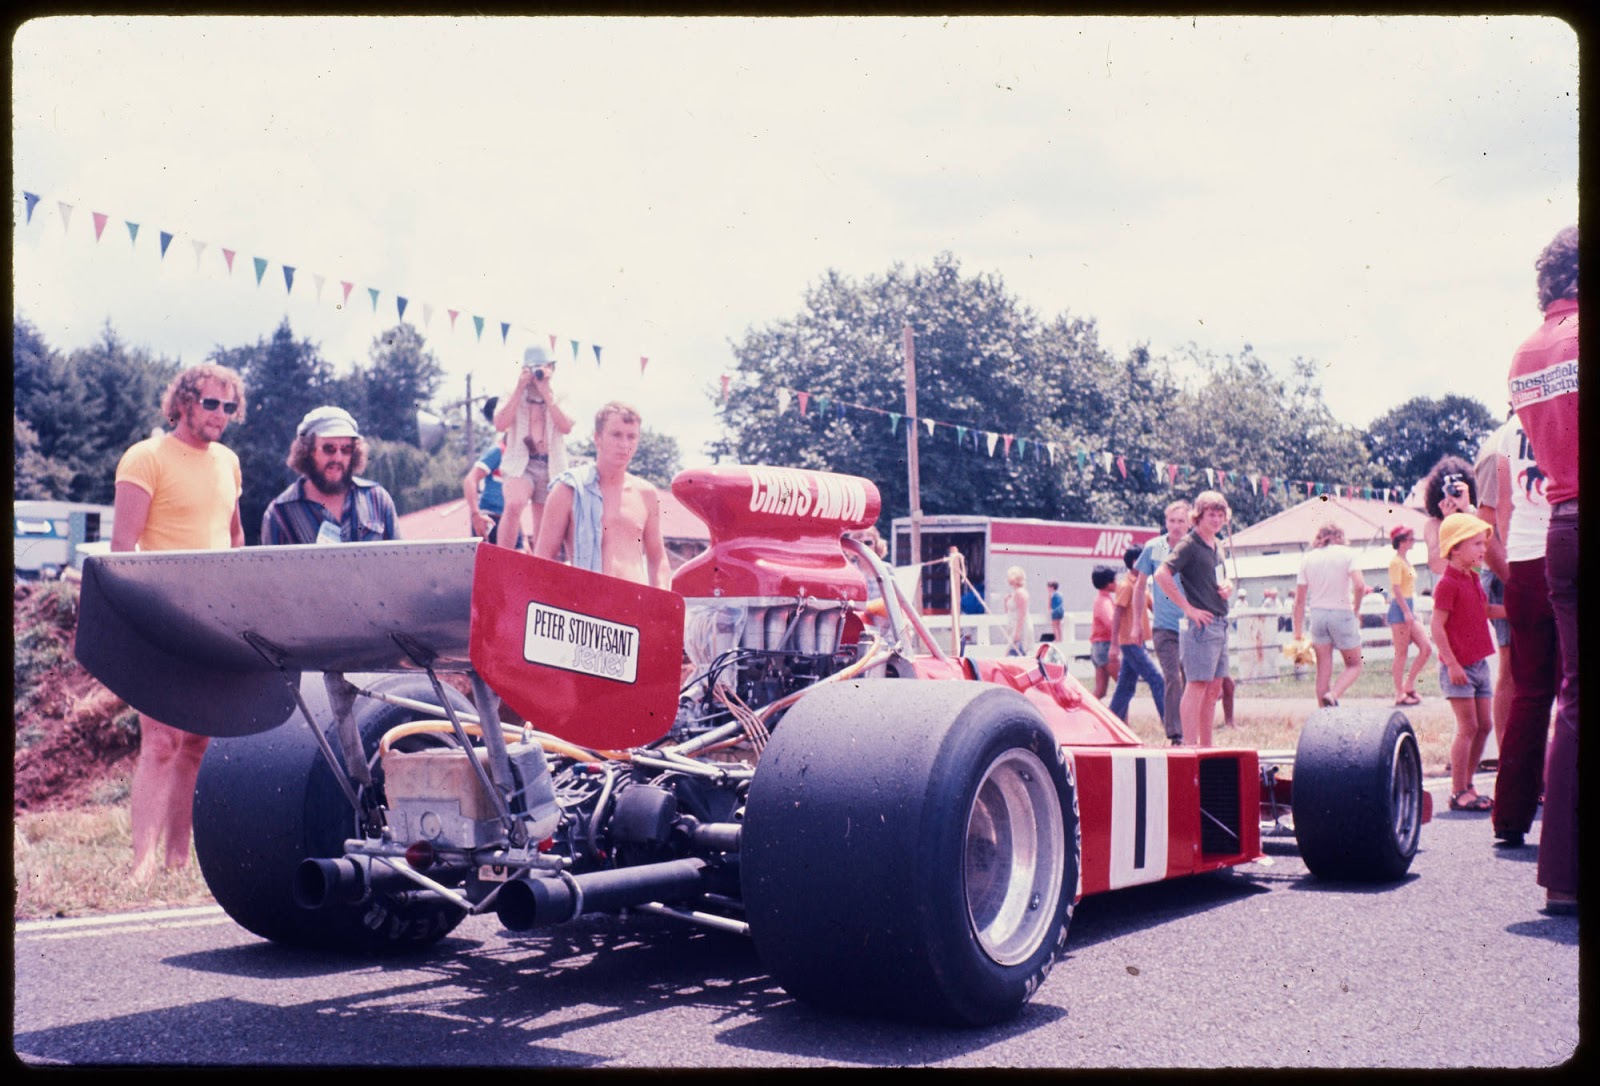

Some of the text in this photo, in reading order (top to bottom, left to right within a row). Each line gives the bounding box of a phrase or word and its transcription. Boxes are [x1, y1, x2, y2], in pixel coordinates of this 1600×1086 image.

[748, 467, 867, 523] CHRIS AMON
[1093, 531, 1134, 556] AVIS
[534, 608, 634, 657] PETER STUYVESANT
[572, 643, 628, 677] series
[1133, 757, 1147, 869] 1
